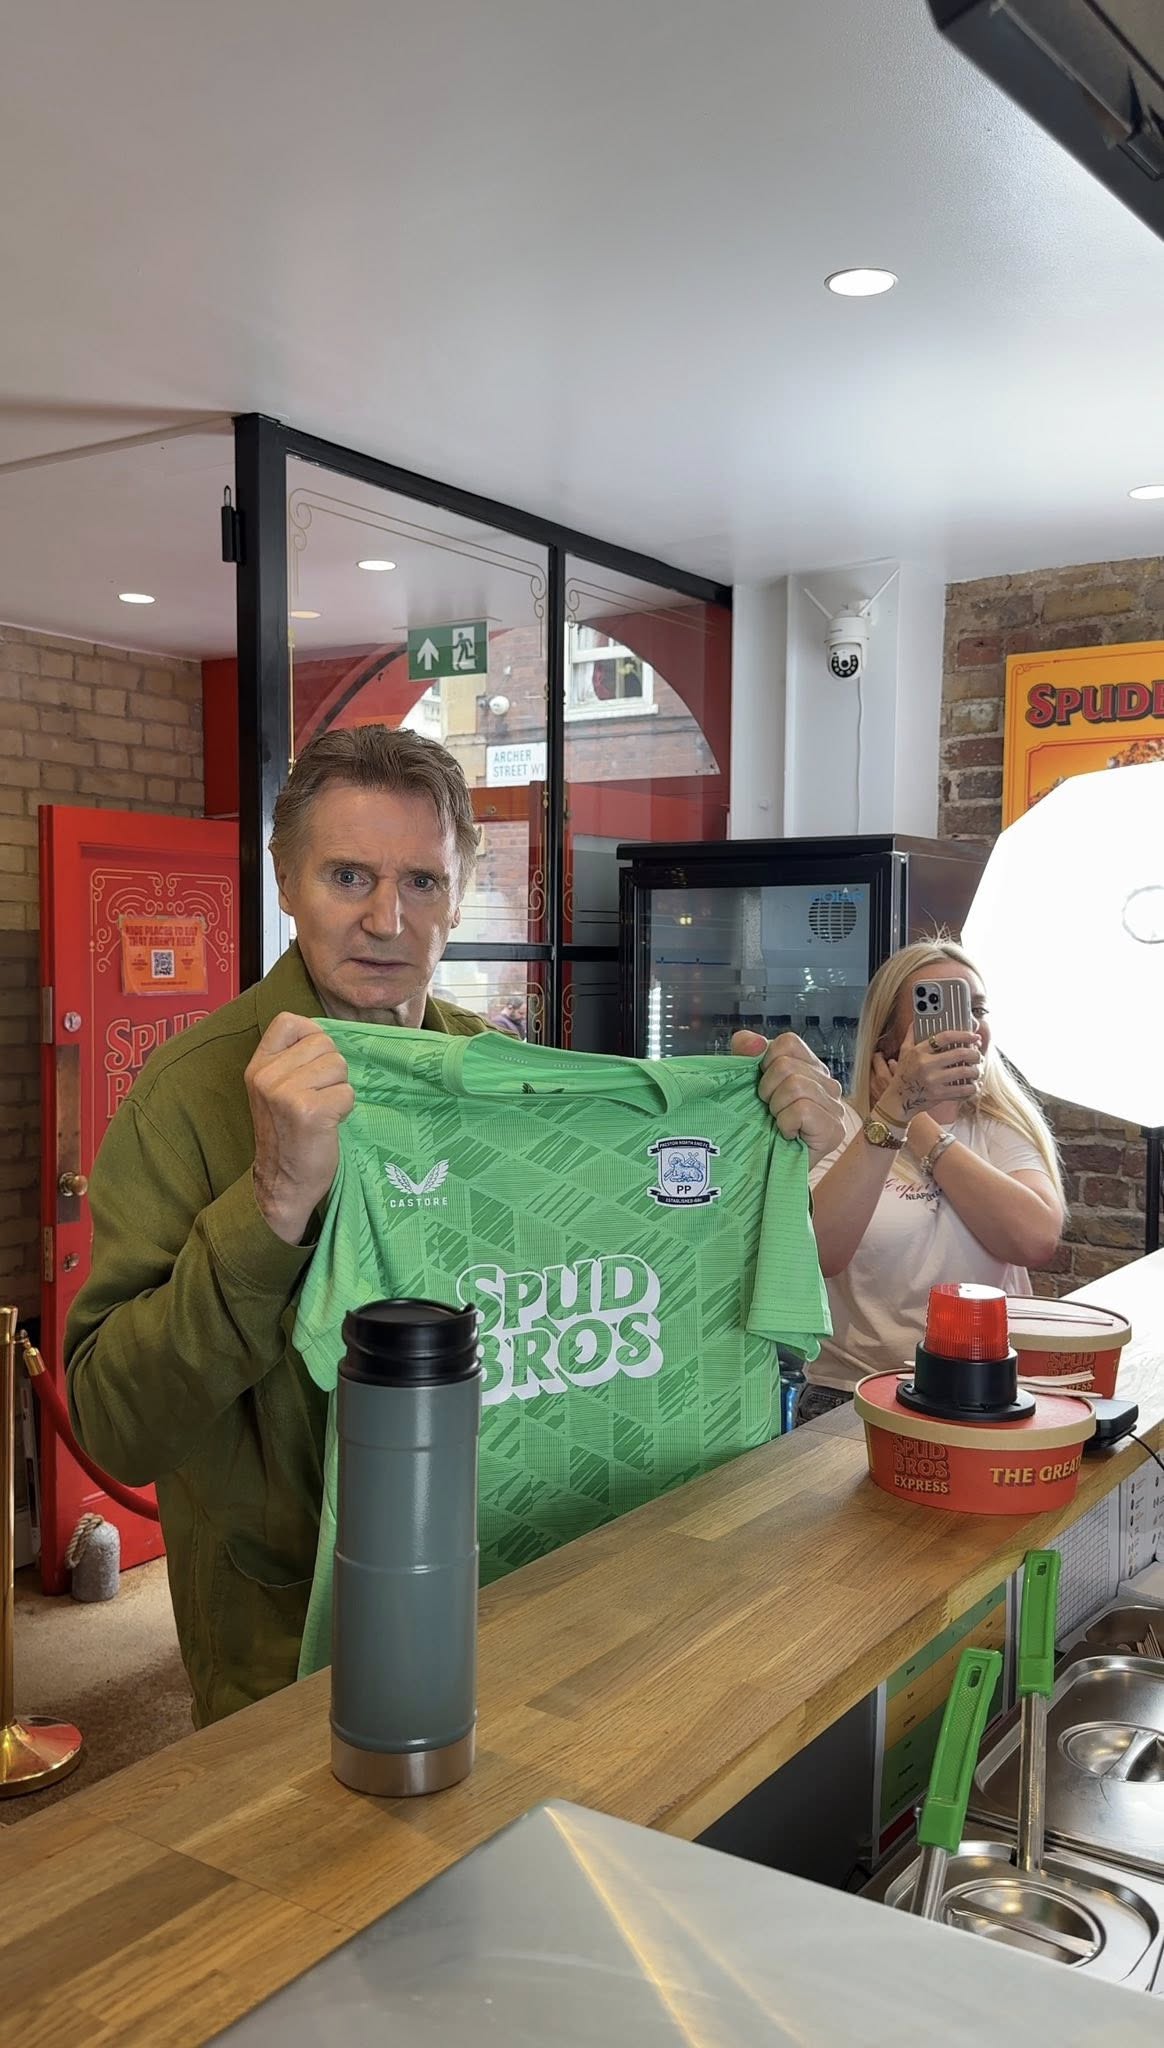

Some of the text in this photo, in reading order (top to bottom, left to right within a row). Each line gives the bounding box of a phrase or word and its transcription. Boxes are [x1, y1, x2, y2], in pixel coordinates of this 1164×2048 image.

[494, 750, 532, 763] ARCHER
[493, 762, 546, 778] STREET W1
[677, 1185, 691, 1194] PP
[390, 1197, 448, 1208] CASTORE
[456, 1254, 661, 1335] SPUD
[892, 1434, 949, 1461] SPUD
[892, 1453, 951, 1480] BROS
[894, 1475, 949, 1494] EXPRESS
[990, 1467, 1036, 1486] THE
